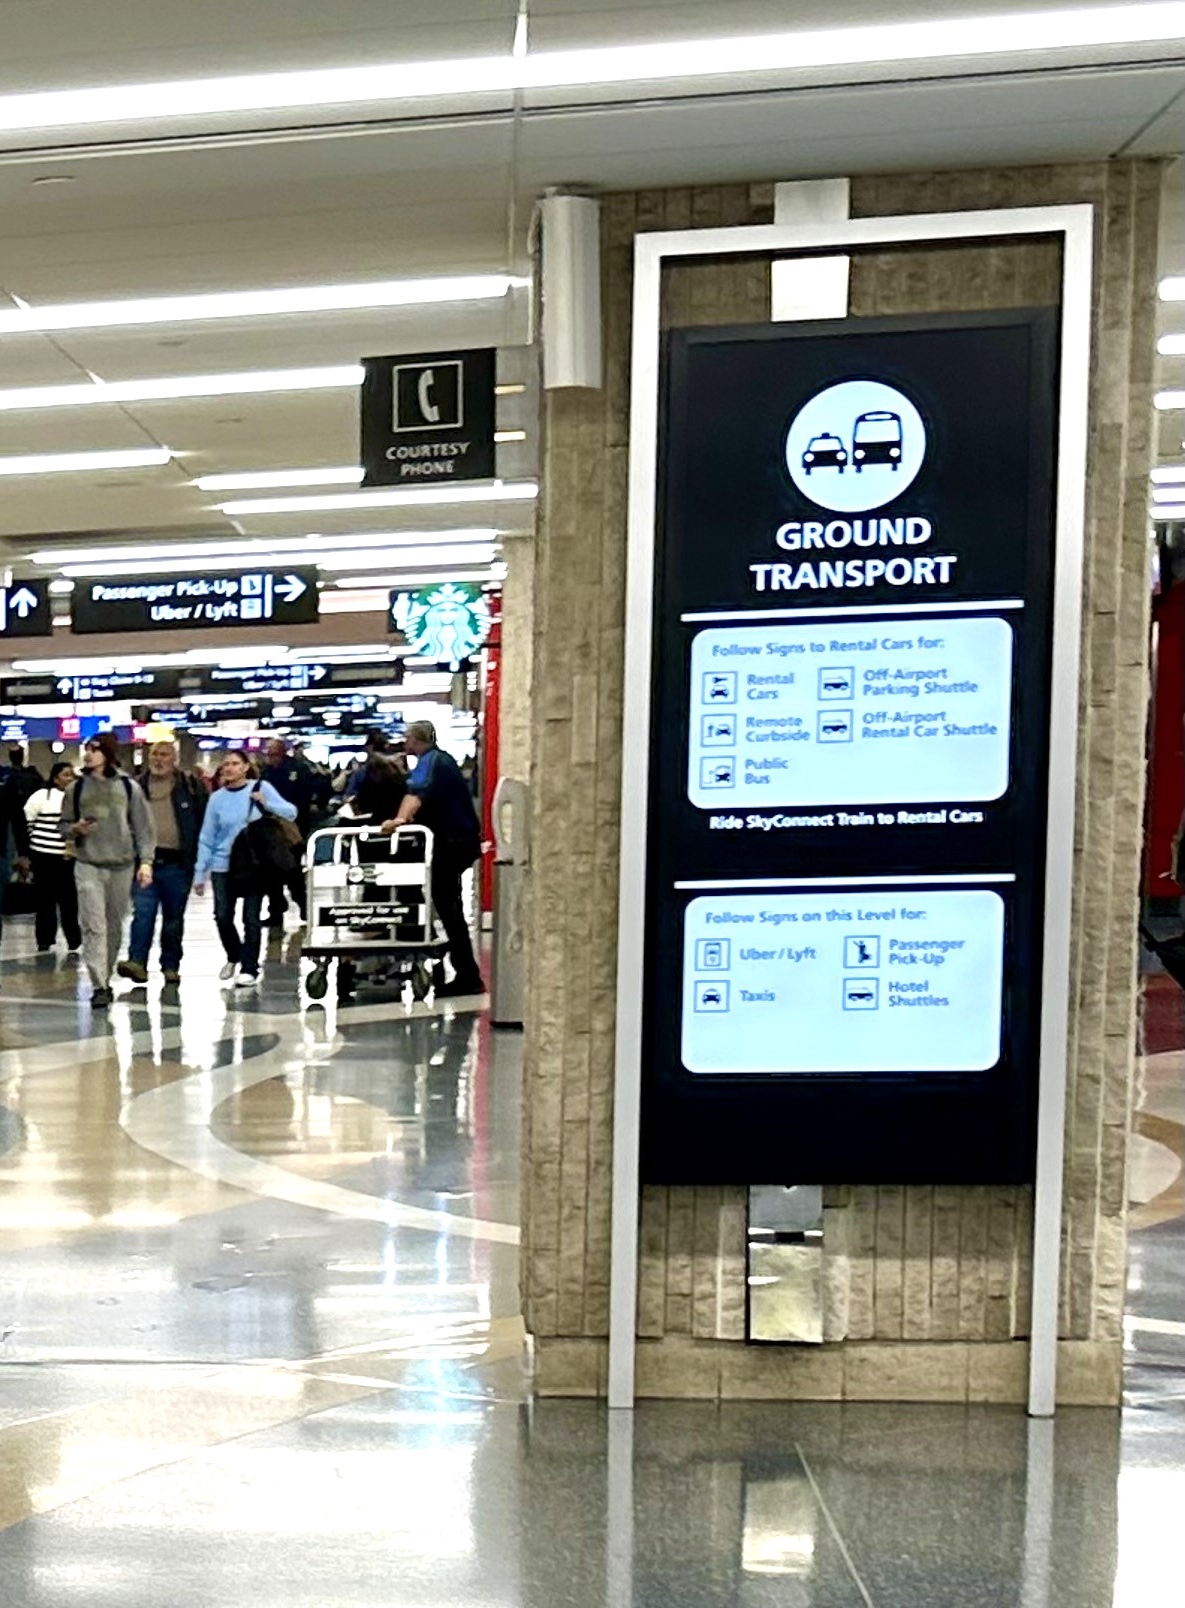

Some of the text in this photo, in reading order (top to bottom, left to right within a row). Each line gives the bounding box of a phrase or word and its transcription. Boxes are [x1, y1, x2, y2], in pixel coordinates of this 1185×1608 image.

[385, 442, 471, 460] COURTESY
[400, 460, 455, 476] PHONE
[776, 517, 931, 550] GROUND
[749, 556, 957, 591] TRANSPORT
[92, 580, 238, 601] Passenger Pick-Up
[151, 606, 191, 621] Uber
[205, 603, 238, 620] Lyft
[712, 644, 762, 656] Follow
[766, 642, 806, 657] Signs
[810, 642, 826, 653] to
[829, 639, 877, 652] Rental
[881, 638, 913, 650] Cars
[747, 672, 794, 685] Rental
[864, 668, 947, 682] Off-Airport
[747, 688, 779, 700] Cars
[863, 680, 978, 697] Parking Shuttle
[746, 716, 803, 727] Remote
[863, 711, 946, 725] Off-Airport
[745, 730, 810, 742] Curbside
[862, 723, 997, 739] Rental Car Shuttle
[745, 756, 789, 769] Public
[744, 773, 771, 785] Bus
[710, 809, 984, 831] Ride SkyConnect Train to Rental Cars
[705, 912, 755, 924] Follow
[759, 911, 798, 926] Signs
[802, 912, 821, 922] on
[825, 909, 853, 921] this
[857, 908, 896, 921] Level
[889, 939, 966, 953] Passenger
[889, 953, 945, 967] Pick-Up
[889, 980, 929, 992] Hotel
[739, 989, 776, 1001] Taxis
[889, 995, 949, 1007] Shuttles
